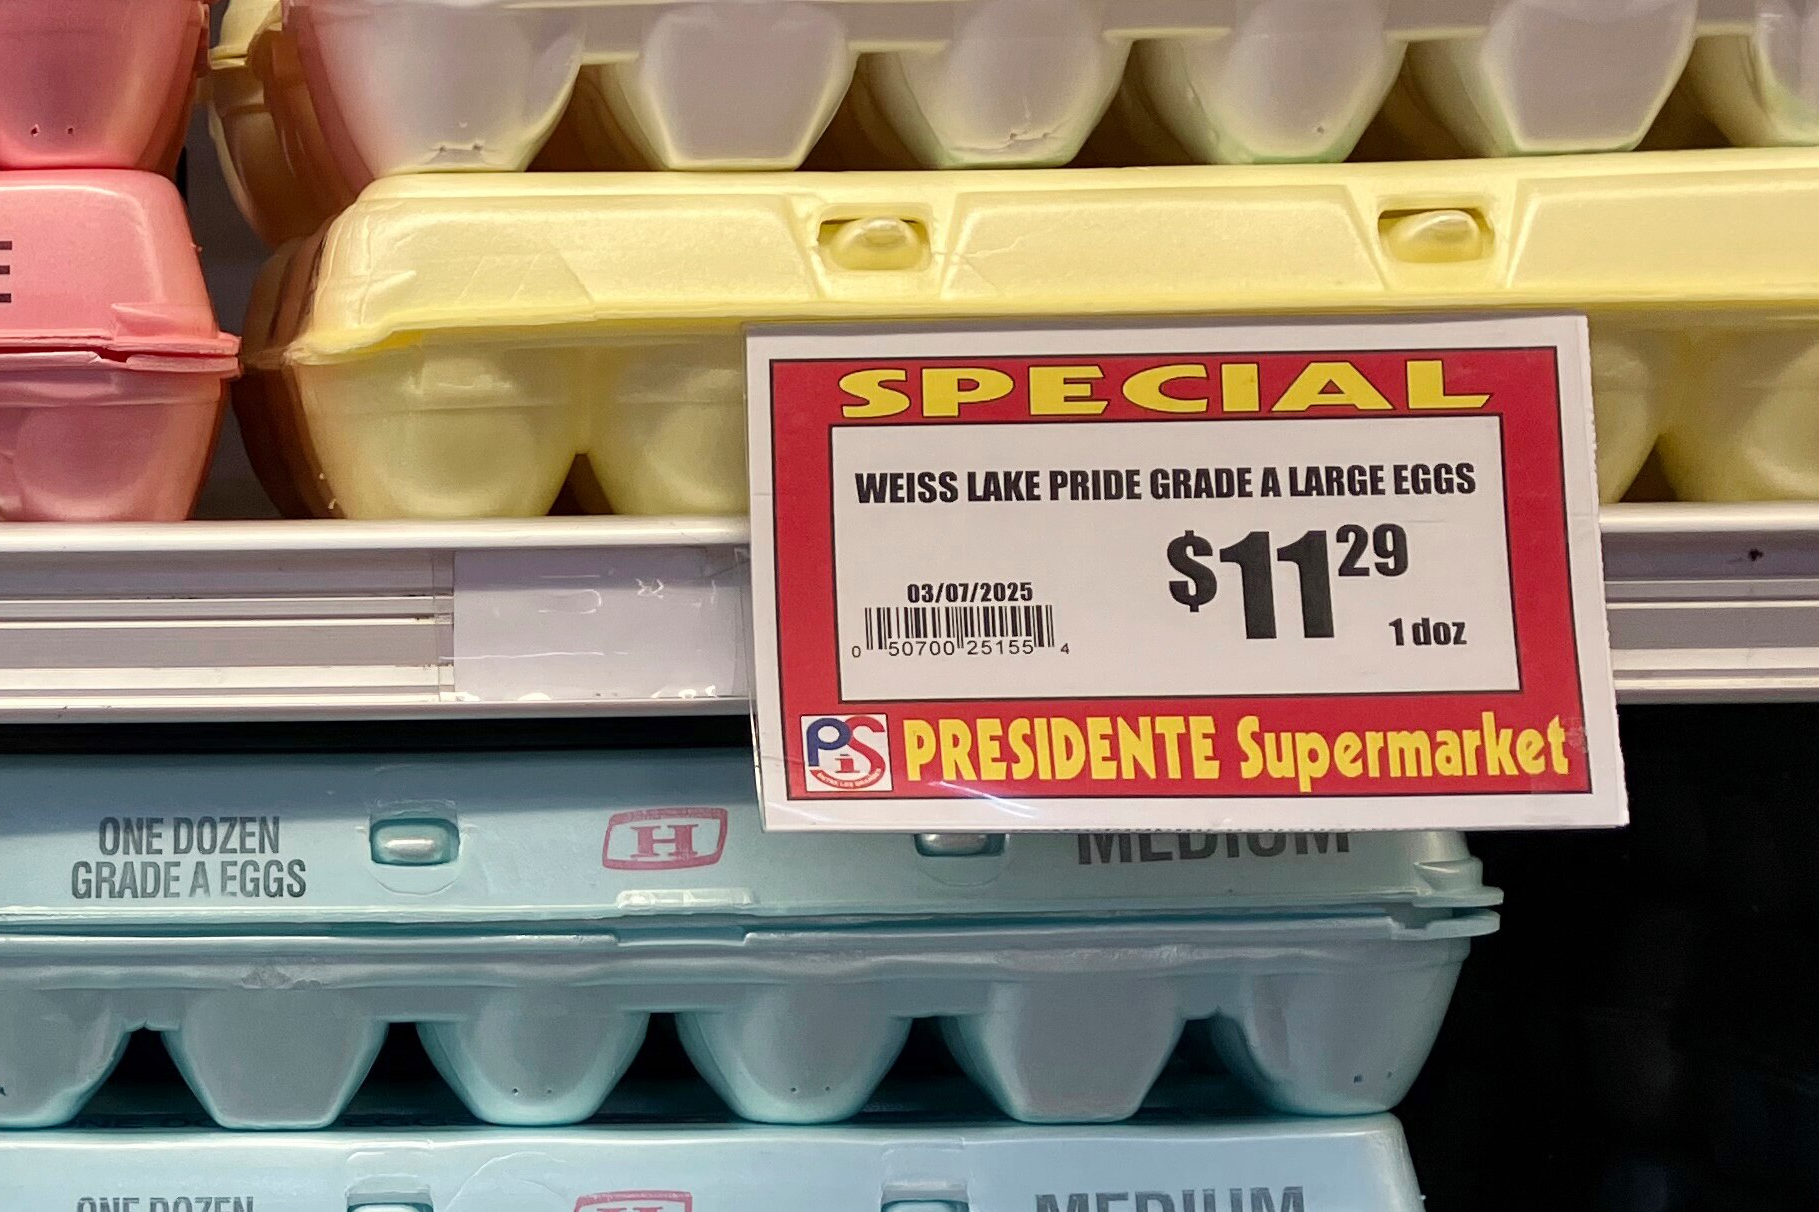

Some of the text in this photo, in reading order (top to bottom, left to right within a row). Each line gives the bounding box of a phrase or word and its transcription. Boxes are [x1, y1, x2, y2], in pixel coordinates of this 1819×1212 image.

[838, 361, 1492, 418] SPECIAL
[854, 462, 1476, 504] WEISS LAKE PRIDE GRADE A LARGE EGGS
[907, 582, 1033, 603] 03/07/2025
[851, 639, 1070, 658] 0 50700 25155 4
[1389, 617, 1467, 647] 1 doz
[904, 711, 1570, 793] PRESIDENTE Supermarket
[98, 816, 280, 855] ONE DOZEN
[629, 824, 701, 858] H
[71, 858, 307, 900] GRADE A EGGS
